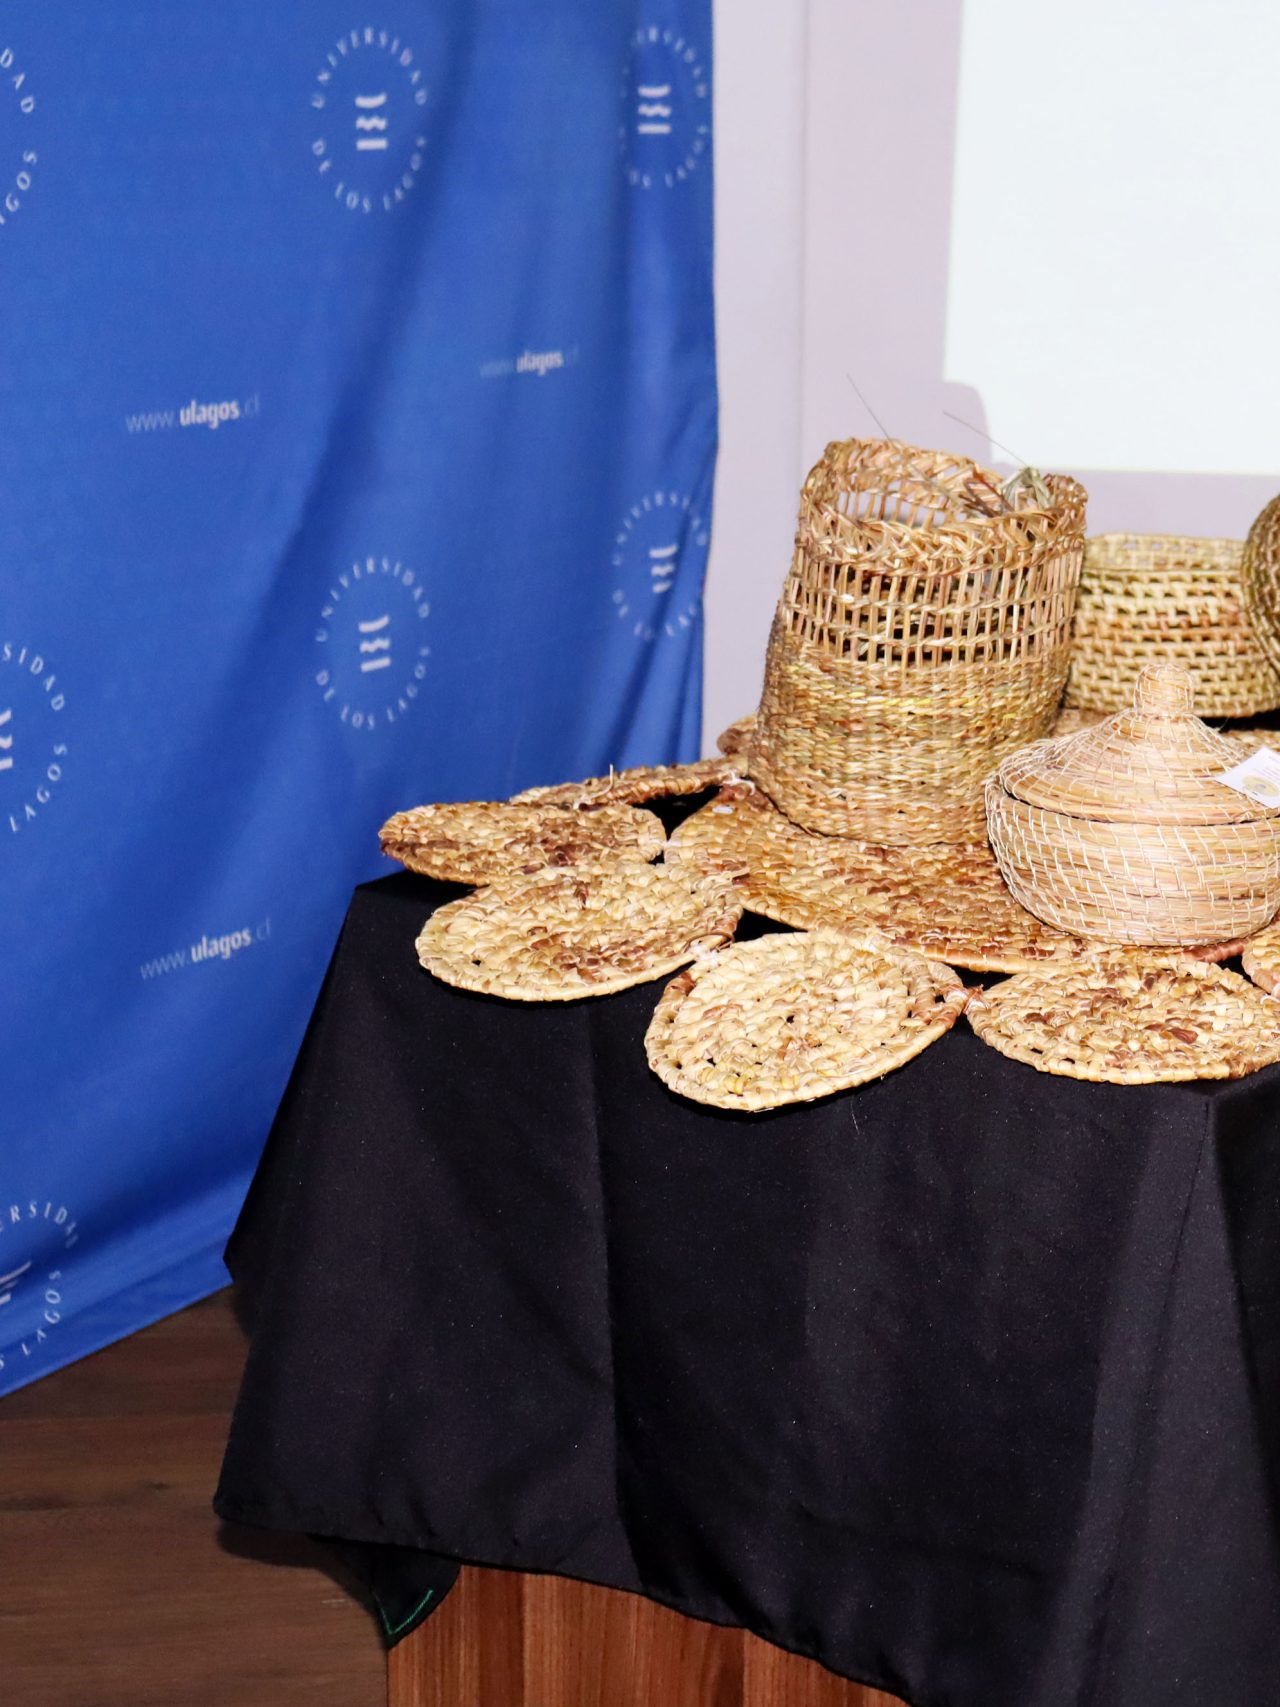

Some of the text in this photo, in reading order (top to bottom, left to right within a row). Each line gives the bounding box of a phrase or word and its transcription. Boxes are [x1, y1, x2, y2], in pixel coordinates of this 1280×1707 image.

[315, 555, 431, 644] UNIVERSIDAD
[9, 743, 69, 834] LAGOS
[139, 915, 272, 981] www.ulagos.cl
